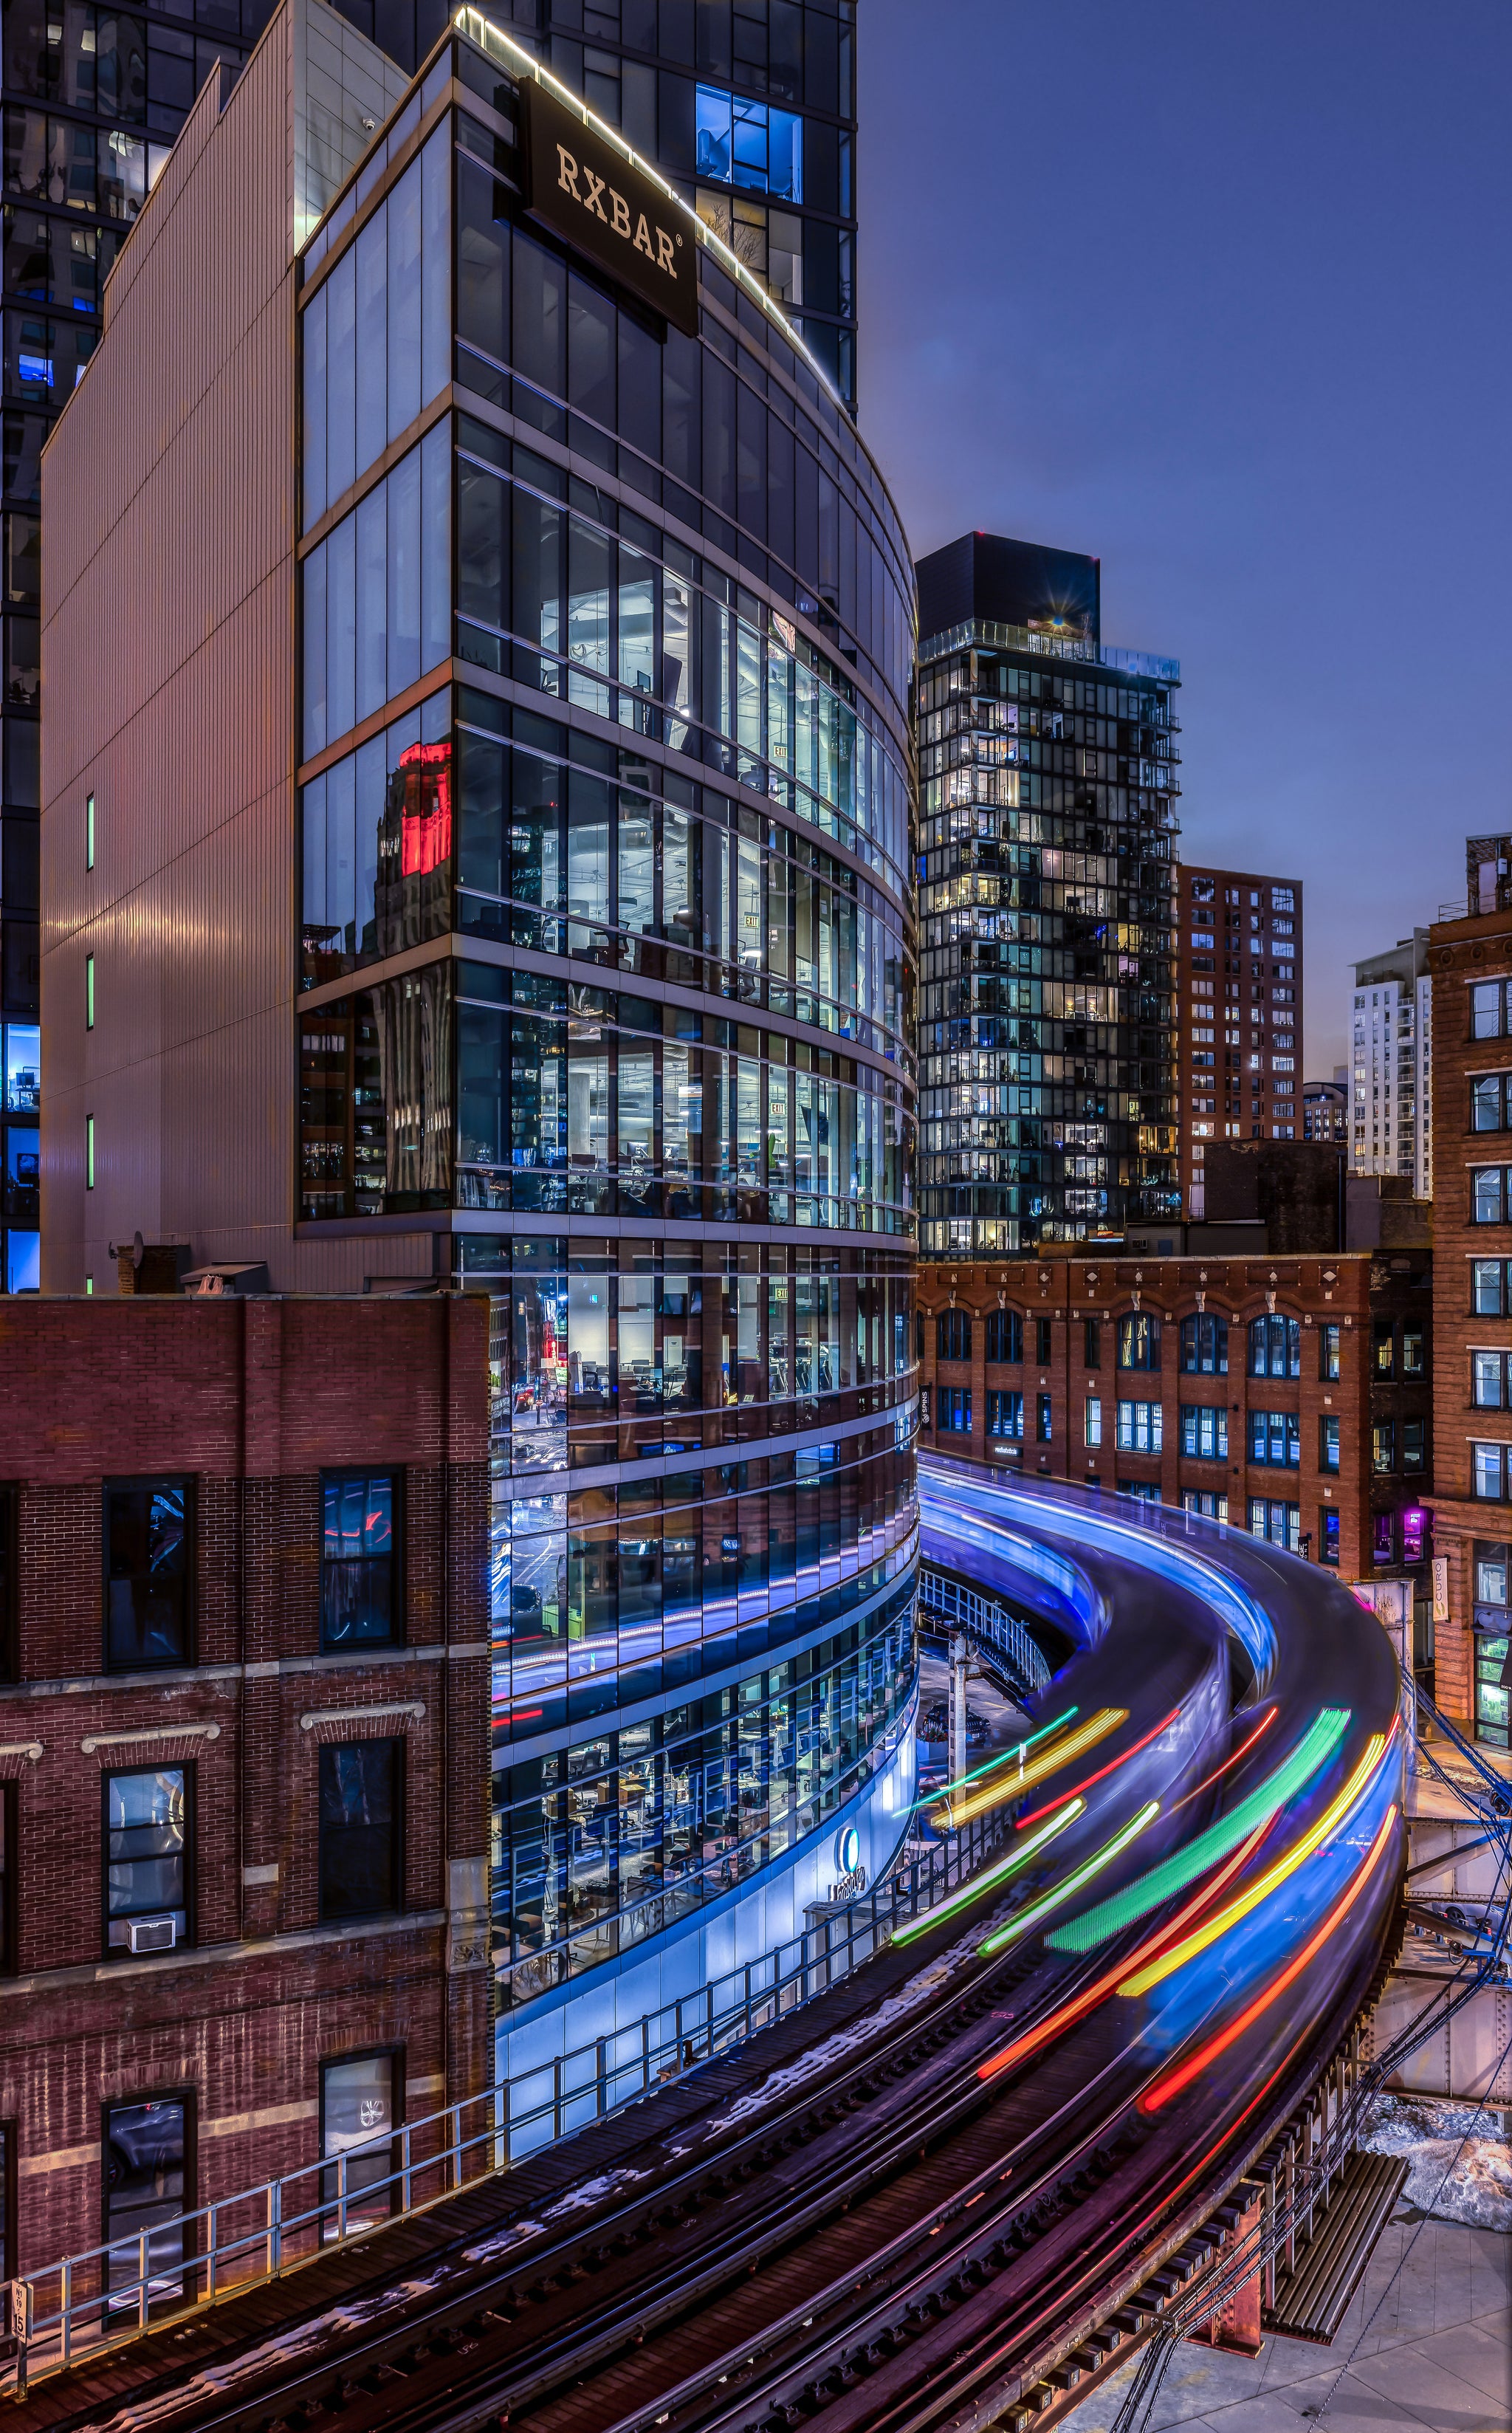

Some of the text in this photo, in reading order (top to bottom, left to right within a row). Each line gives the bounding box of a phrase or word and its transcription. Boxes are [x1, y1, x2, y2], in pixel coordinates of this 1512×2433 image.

[557, 143, 677, 279] RXBAR
[775, 747, 787, 756] EXIT
[746, 916, 757, 925] EXIT
[772, 1104, 783, 1112] EXIT
[13, 2313, 24, 2333] 15
